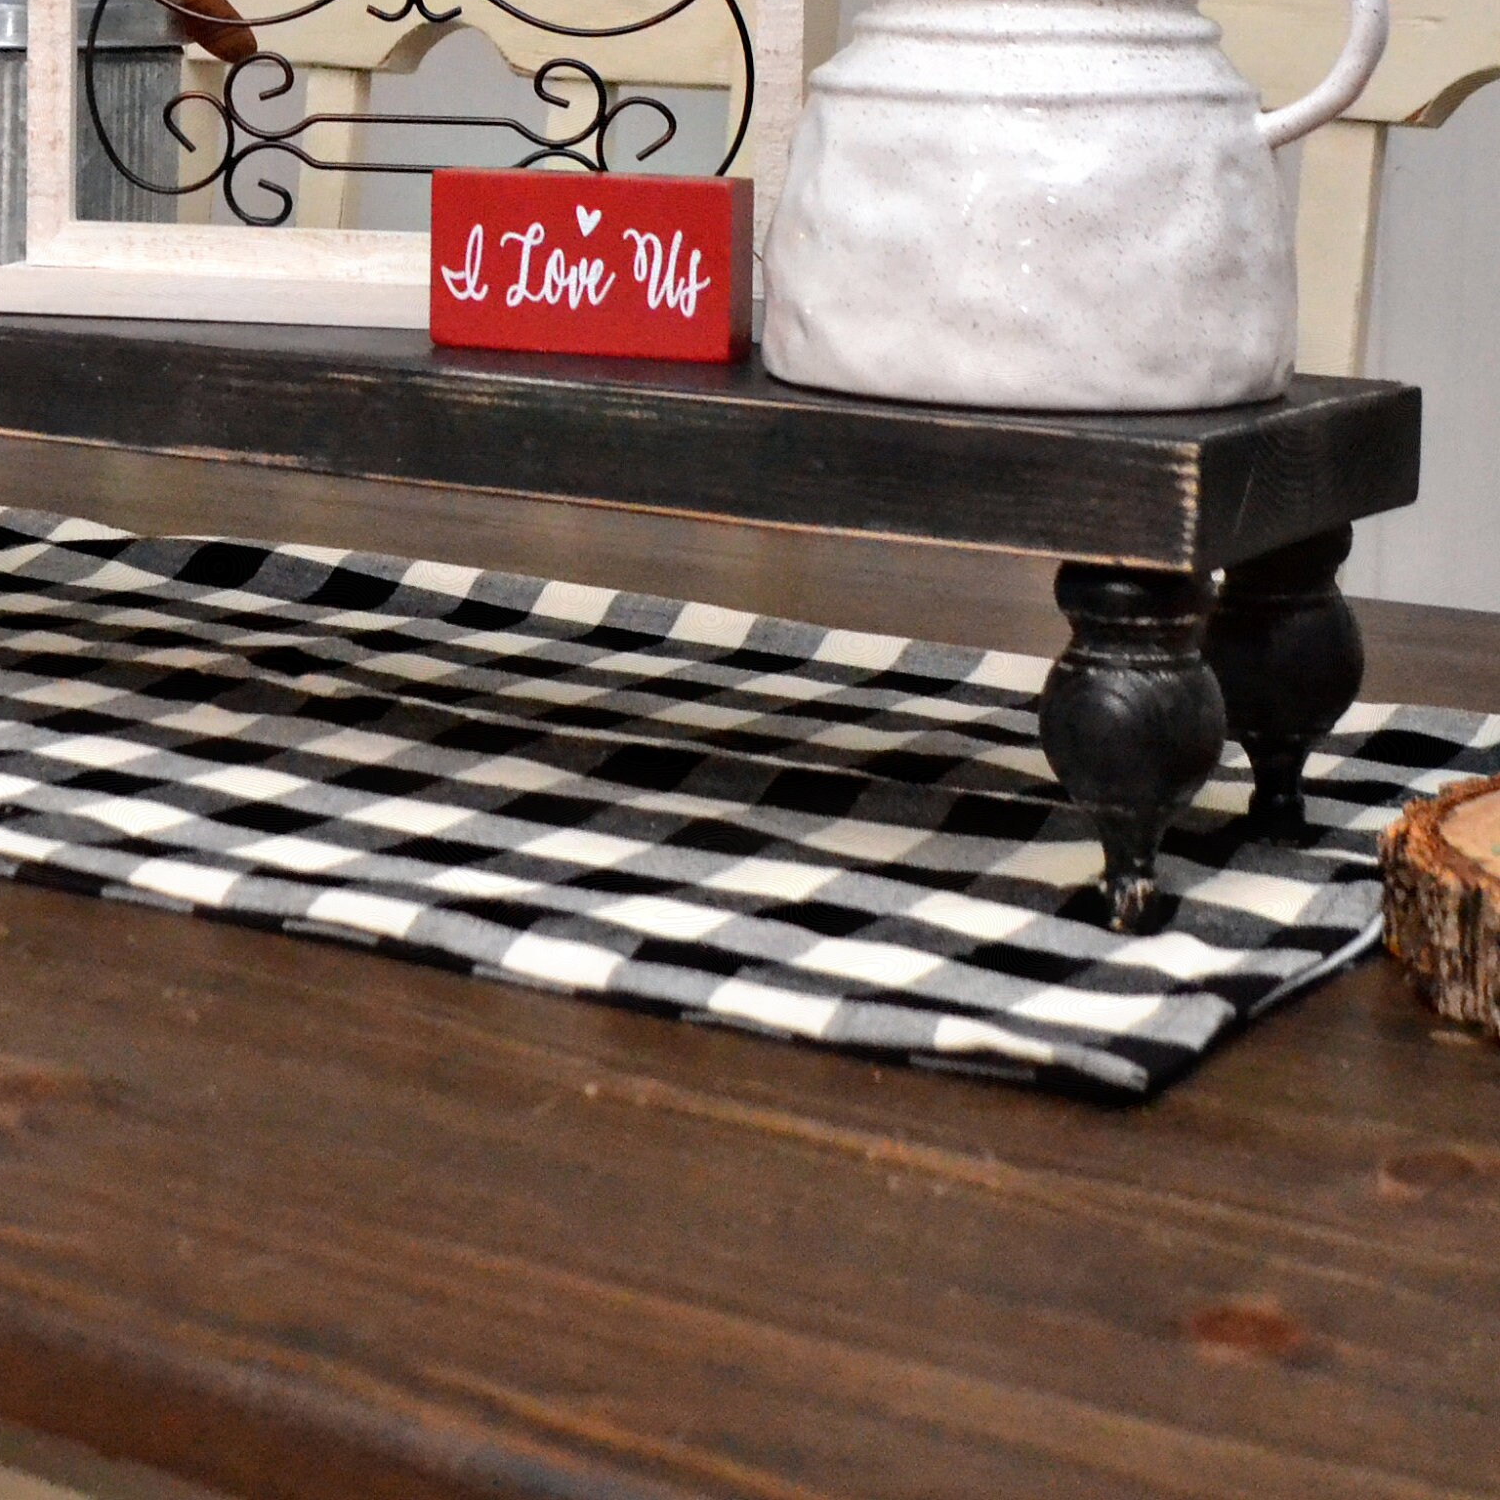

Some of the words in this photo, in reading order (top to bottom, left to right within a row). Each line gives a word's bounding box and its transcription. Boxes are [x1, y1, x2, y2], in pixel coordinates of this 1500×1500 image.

[441, 223, 489, 301] I
[500, 221, 617, 311] Love
[623, 228, 711, 318] Us
